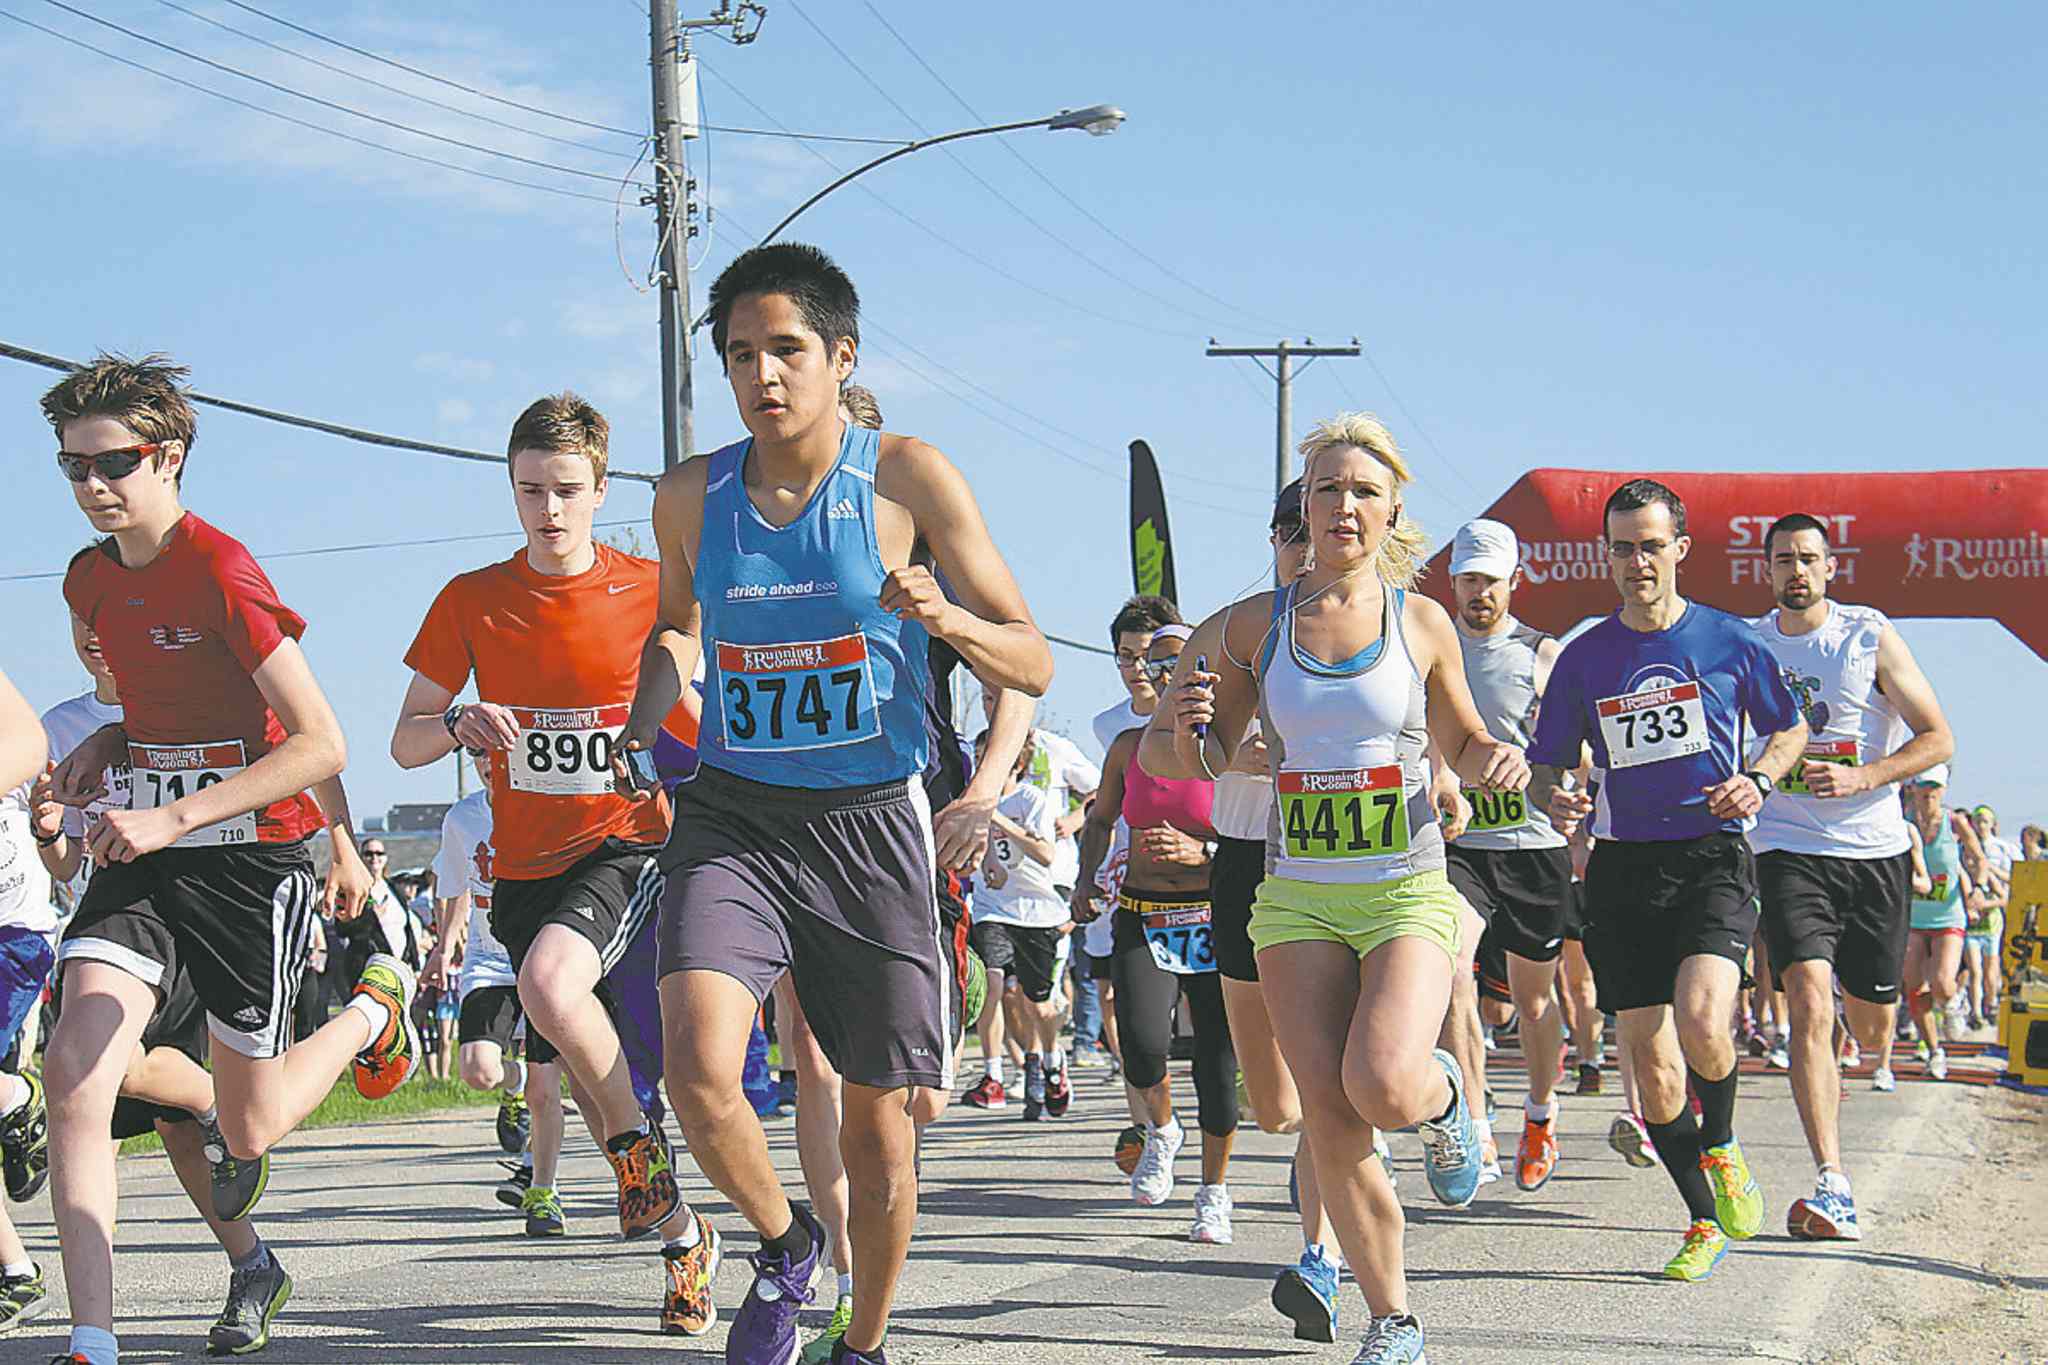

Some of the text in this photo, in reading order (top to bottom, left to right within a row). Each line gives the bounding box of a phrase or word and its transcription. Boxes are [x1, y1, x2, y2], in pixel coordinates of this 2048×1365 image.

[1729, 515, 1856, 546] STT
[1519, 535, 1605, 572] Runni
[1731, 558, 1856, 584] FIH
[726, 584, 766, 599] stride
[769, 580, 814, 597] ahead
[753, 646, 815, 667] Running
[725, 668, 862, 740] 3747
[1616, 705, 1688, 748] 733
[527, 732, 612, 774] 890
[604, 780, 615, 791] 8
[1311, 770, 1362, 789] Running
[220, 829, 244, 842] 710
[1288, 794, 1397, 851] 4417
